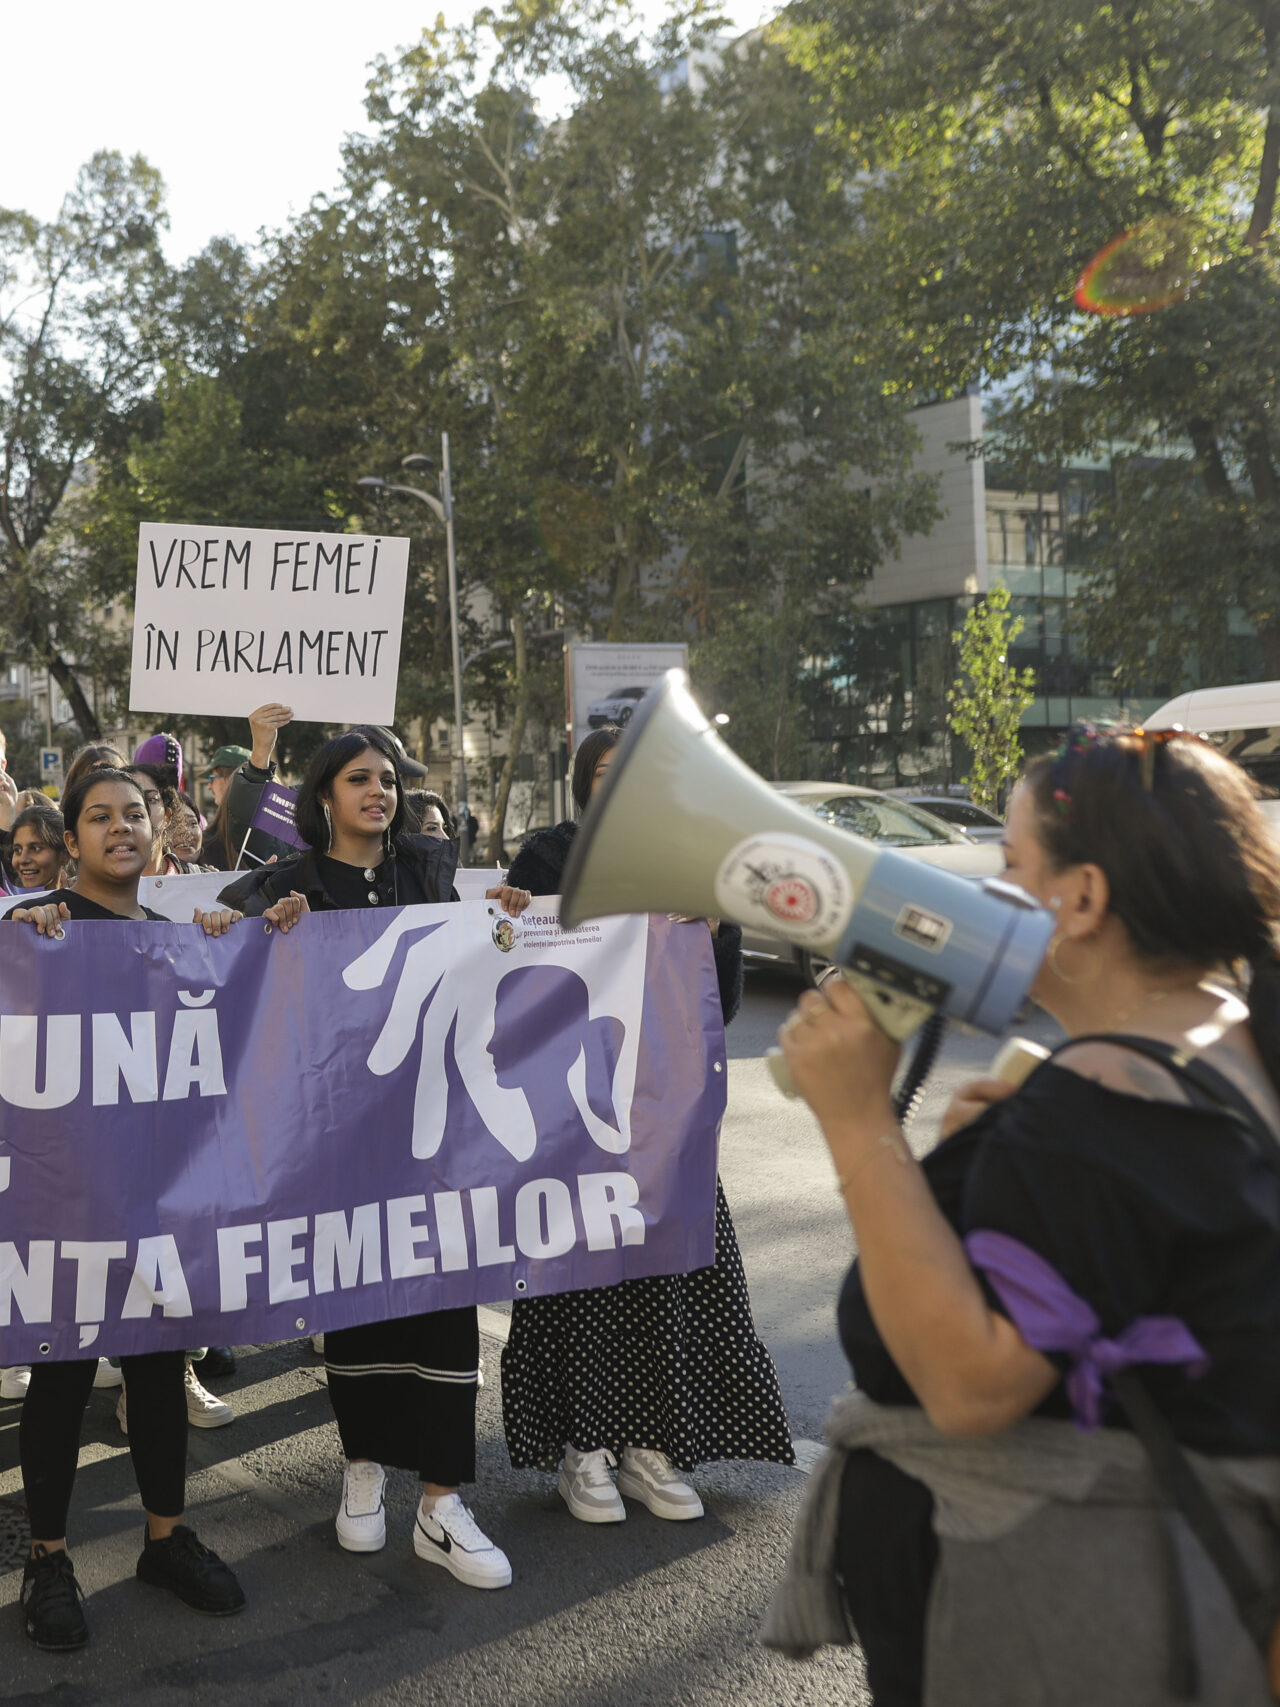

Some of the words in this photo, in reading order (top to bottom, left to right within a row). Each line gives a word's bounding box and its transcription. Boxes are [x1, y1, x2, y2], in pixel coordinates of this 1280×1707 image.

[149, 538, 252, 590] VREM
[270, 539, 382, 595] FEMEI
[144, 623, 180, 671] ÎN
[196, 629, 389, 677] PARLAMENT
[43, 752, 59, 769] P
[216, 1171, 646, 1313] FEMEILOR
